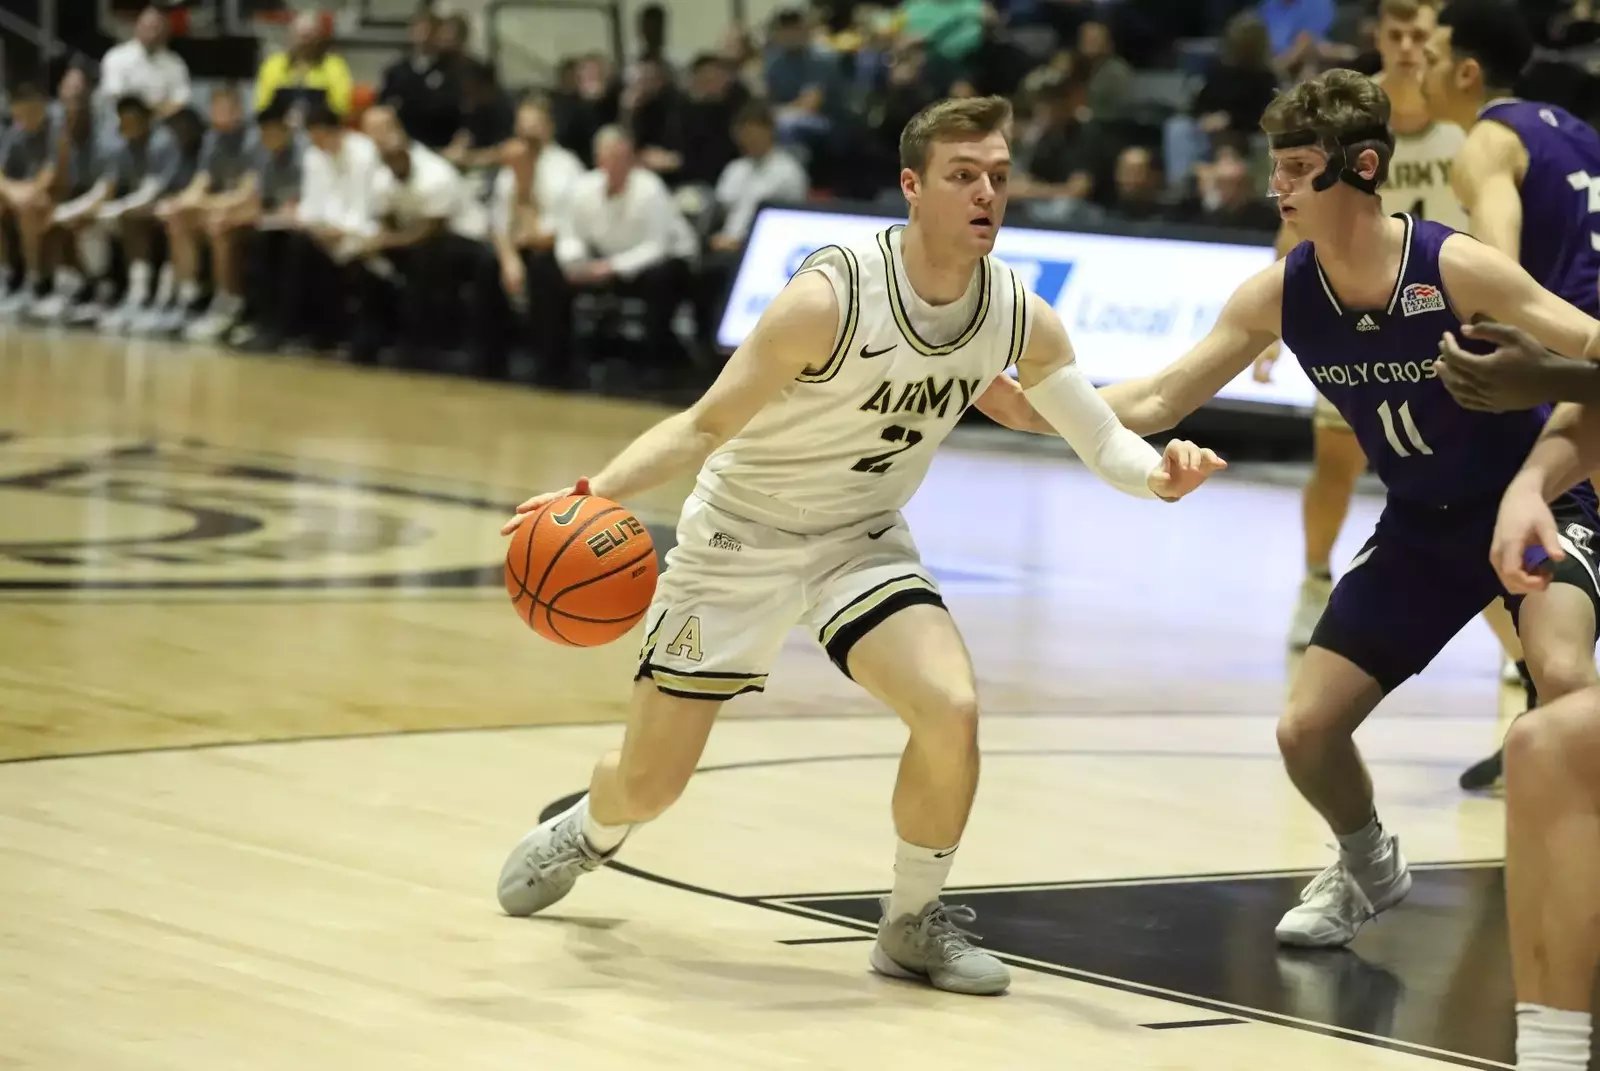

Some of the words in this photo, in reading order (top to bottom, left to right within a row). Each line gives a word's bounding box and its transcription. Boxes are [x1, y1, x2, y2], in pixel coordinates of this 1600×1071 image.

[1379, 158, 1454, 188] RMY
[1404, 294, 1440, 307] PATRIOT
[1406, 301, 1443, 313] LEAGUE
[1312, 362, 1369, 386] HOLY
[859, 376, 981, 418] ARMY
[850, 424, 924, 473] 2
[1376, 399, 1433, 458] 11
[586, 516, 646, 558] ELITE
[666, 615, 704, 662] A
